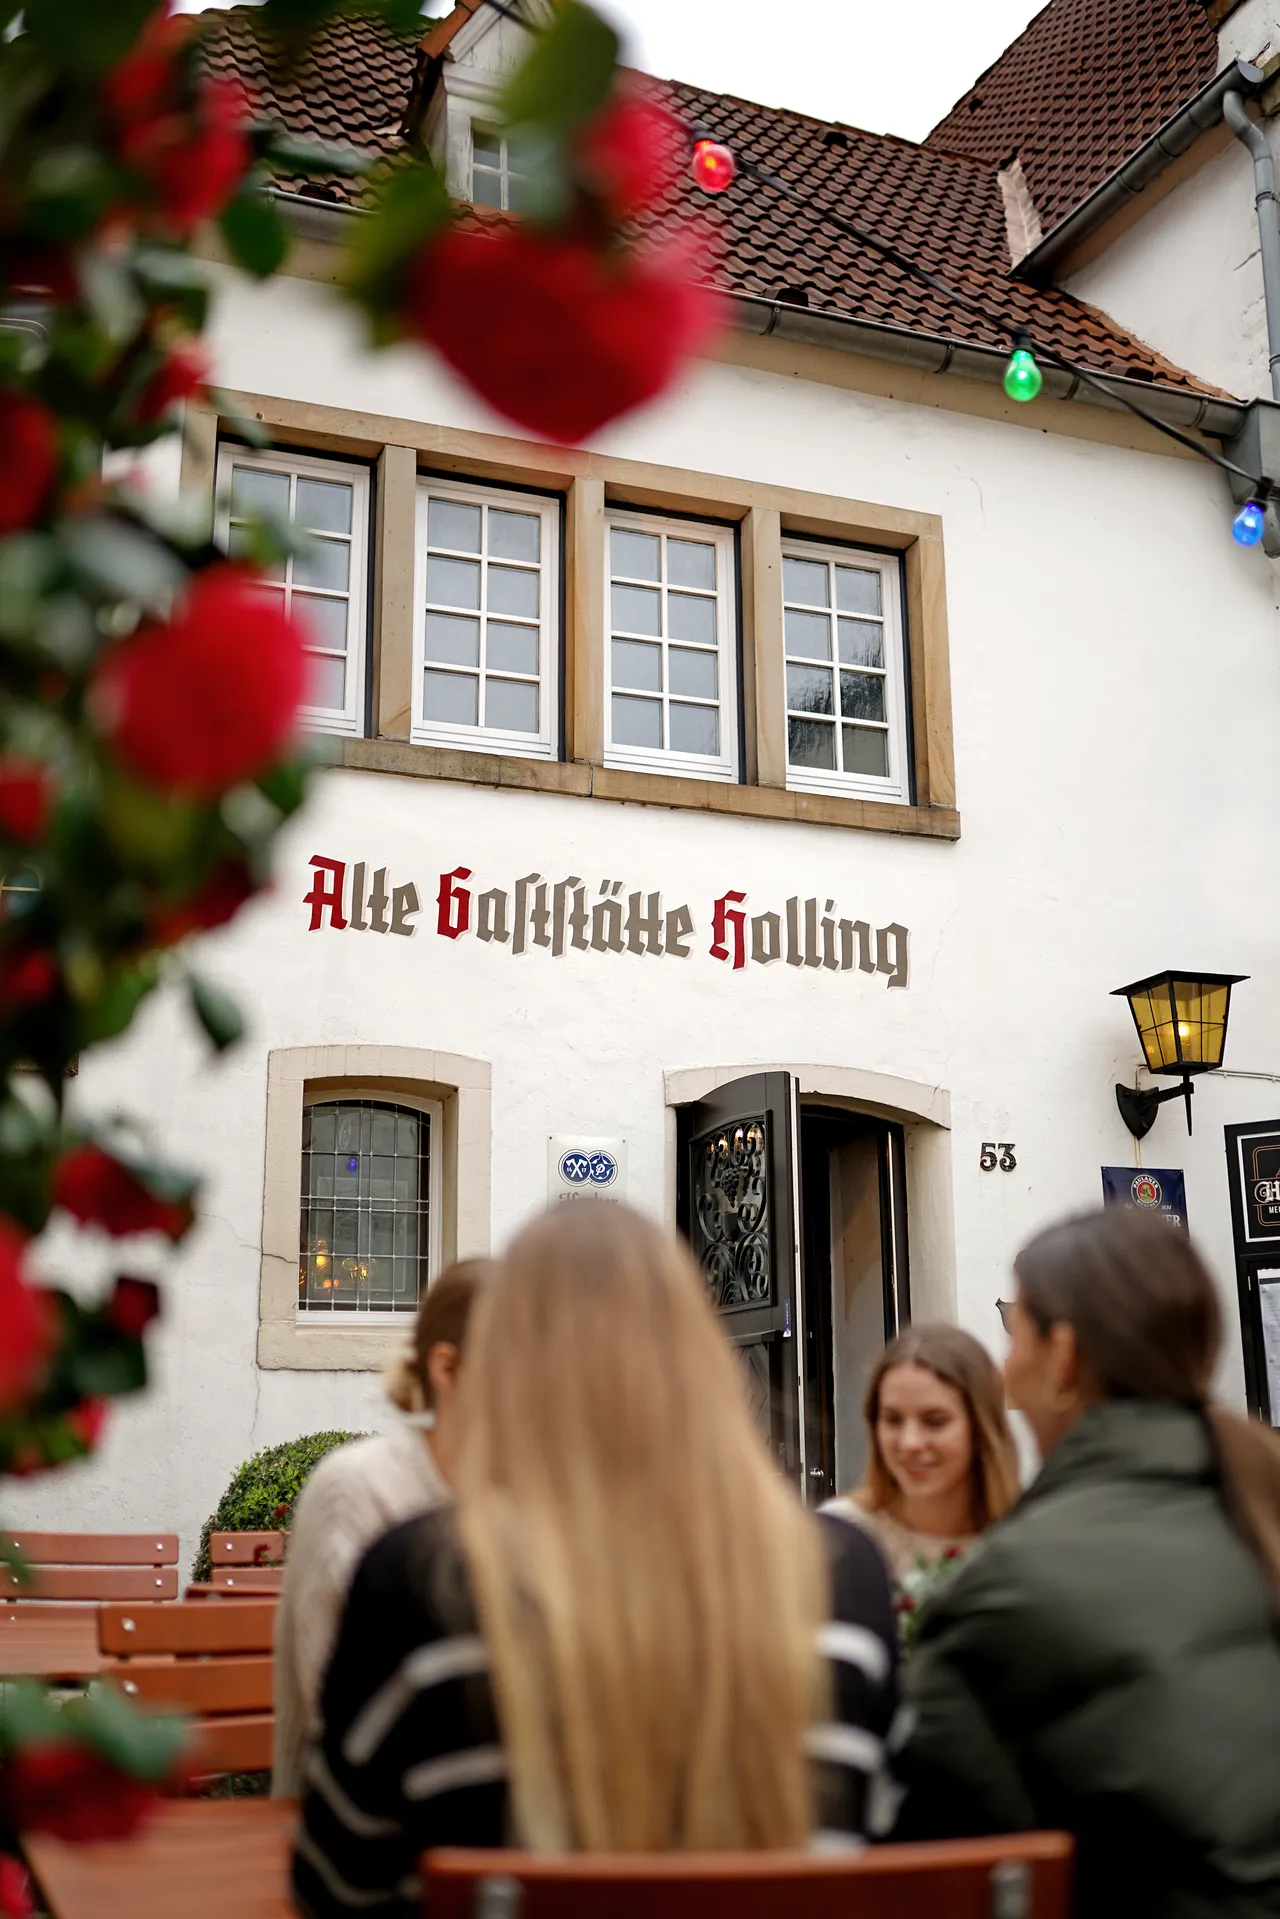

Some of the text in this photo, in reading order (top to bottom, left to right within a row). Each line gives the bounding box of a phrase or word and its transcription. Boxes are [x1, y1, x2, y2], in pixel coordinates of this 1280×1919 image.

[303, 855, 420, 937] Alte
[709, 890, 909, 989] Holling
[980, 1142, 1017, 1172] 53
[1133, 1176, 1159, 1189] PAULANER
